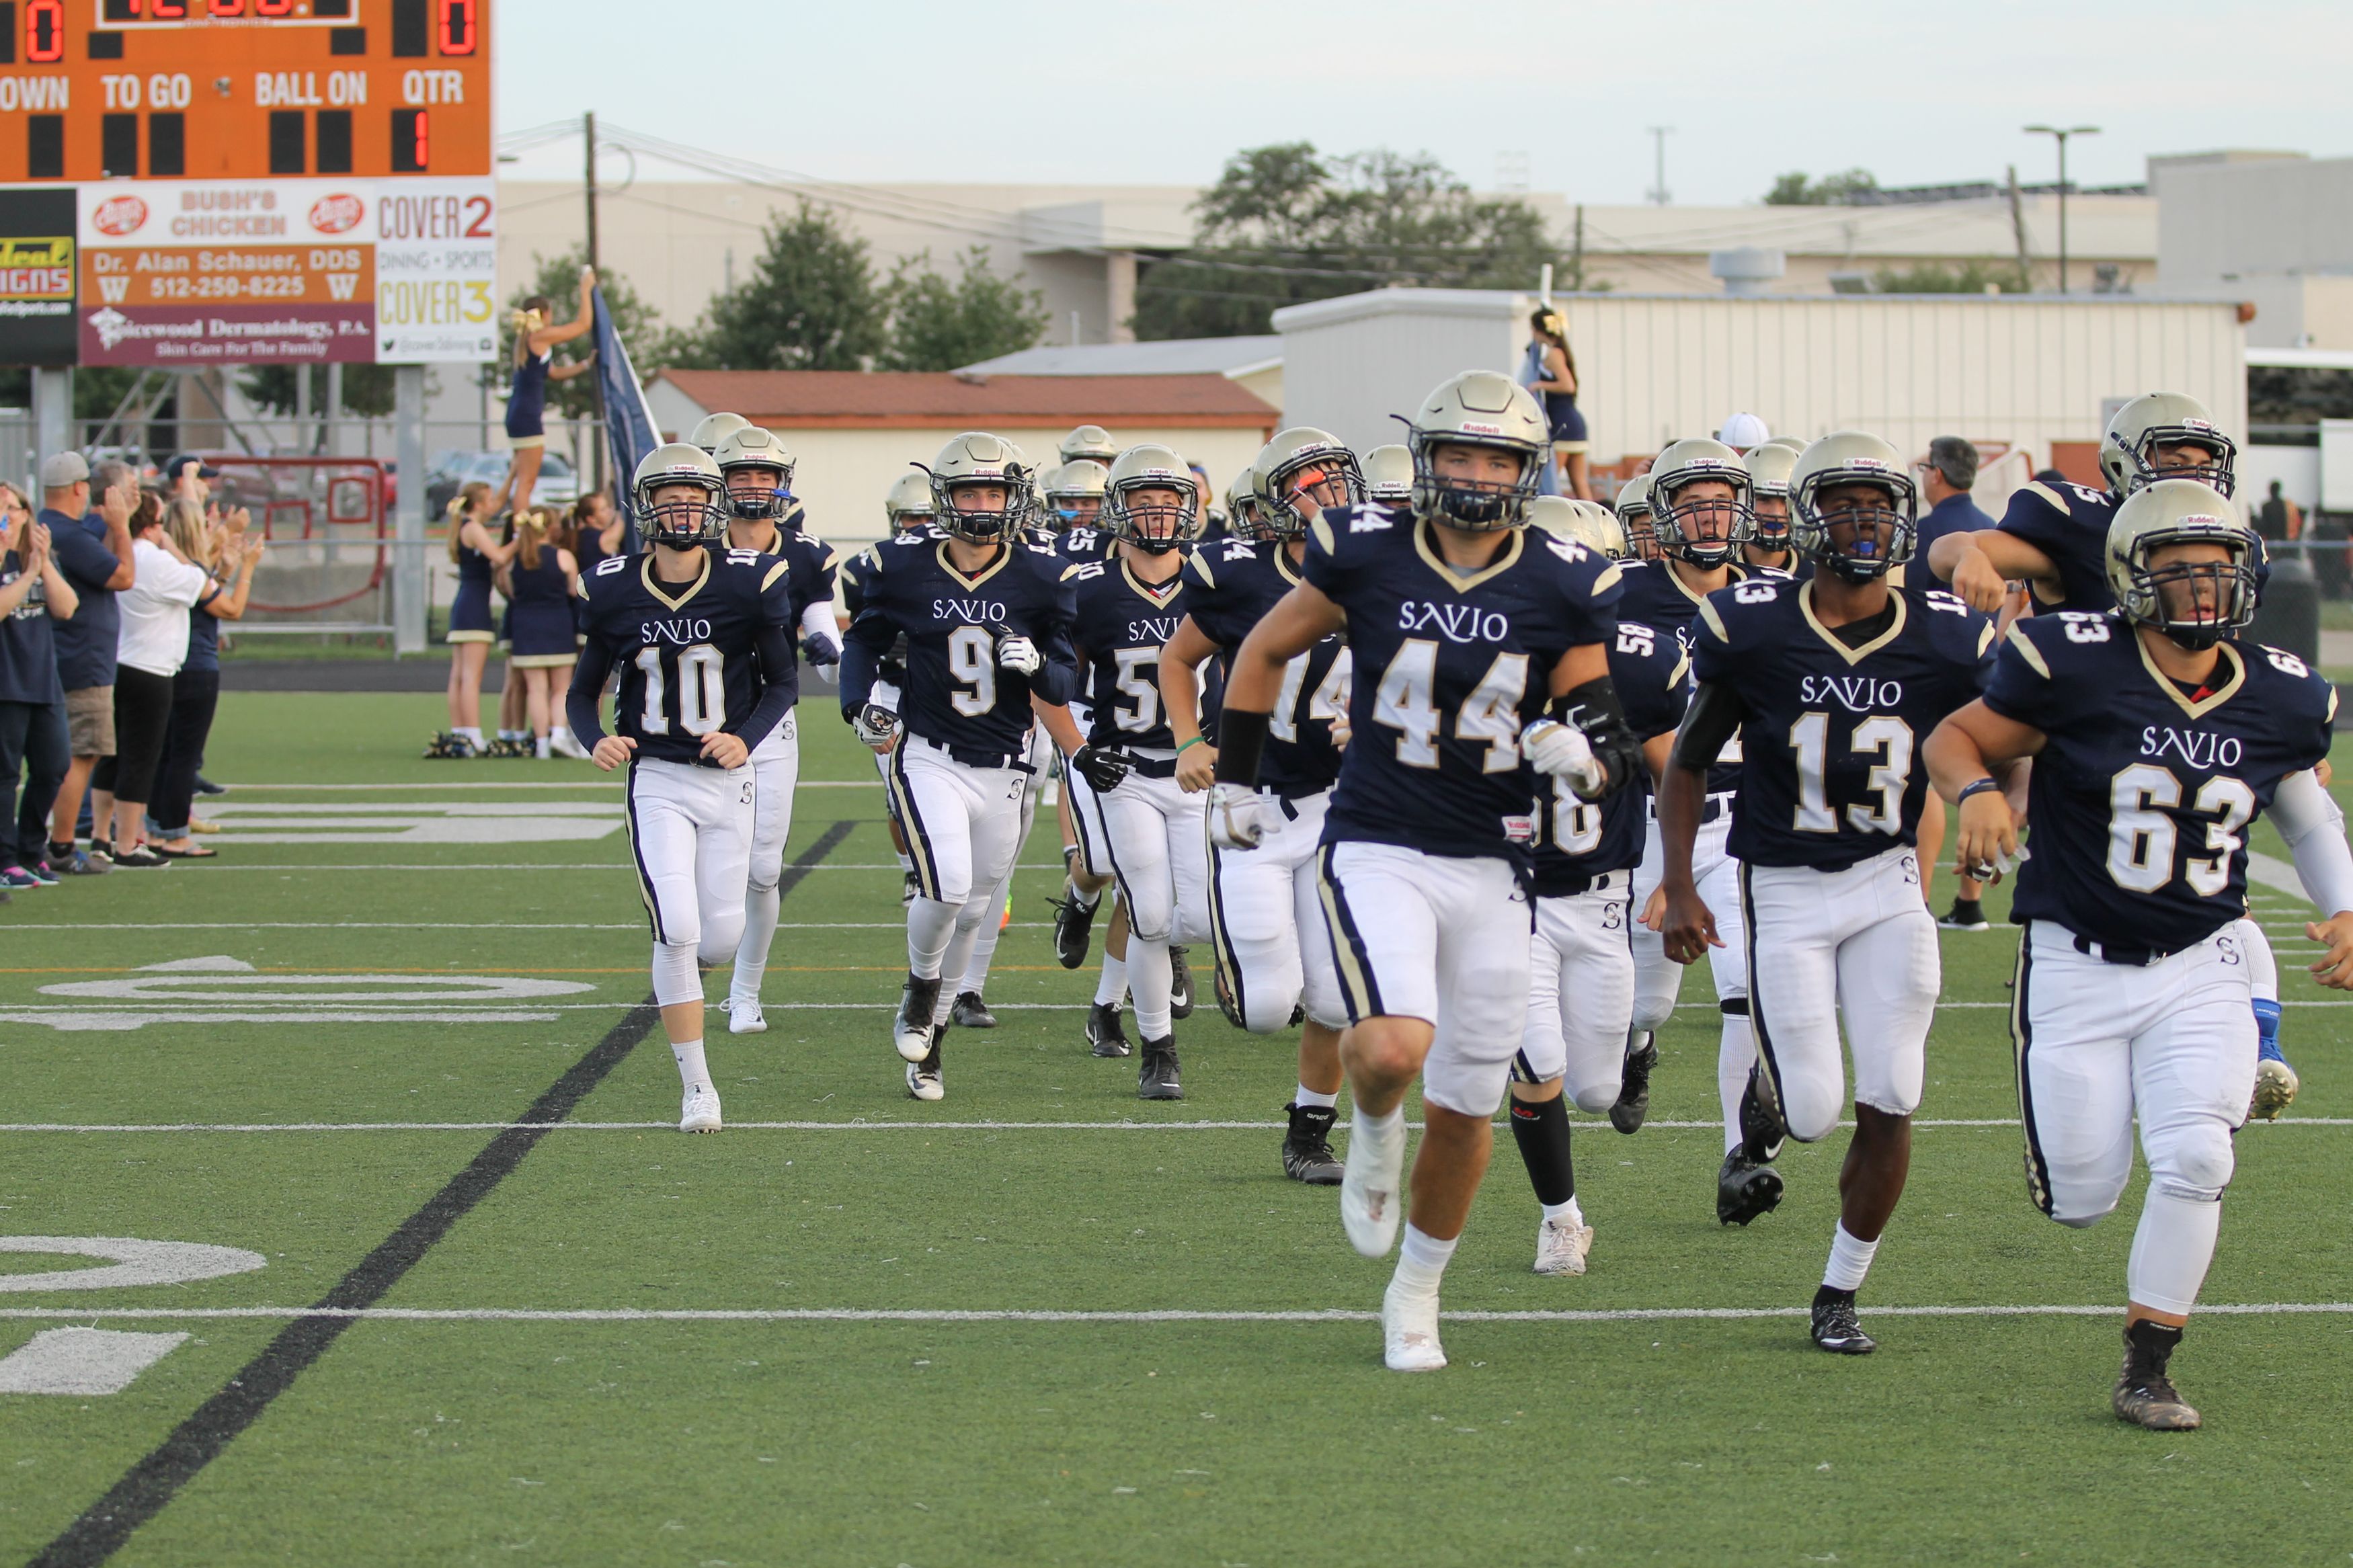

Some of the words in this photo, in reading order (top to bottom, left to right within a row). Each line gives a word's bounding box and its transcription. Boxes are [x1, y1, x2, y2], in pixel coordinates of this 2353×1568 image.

[100, 74, 141, 109] TO
[148, 73, 192, 108] GO
[255, 72, 323, 106] BALL
[328, 71, 367, 105] ON
[403, 69, 464, 104] QTR
[416, 112, 427, 166] 1
[172, 216, 286, 236] CHICKEN
[93, 252, 128, 273] Dr.
[135, 251, 190, 273] Alan
[198, 250, 302, 273] Schauer,
[309, 249, 361, 270] DDS
[380, 251, 430, 270] DINING
[445, 250, 493, 269] SPORTS
[151, 275, 305, 298] 512-250-8225
[1464, 423, 1500, 434] Riddell
[1853, 458, 1881, 466] Riddell
[1067, 527, 1099, 552] 25
[726, 548, 760, 567] 10
[1734, 579, 1778, 604] 13
[933, 598, 1006, 624] SAVIO
[1398, 601, 1508, 643] SAVIO
[2058, 611, 2110, 643] 63
[641, 618, 711, 645] SAVIO
[1128, 617, 1179, 643] SAVI
[1616, 622, 1655, 657] 58
[948, 626, 996, 717] 9
[635, 643, 727, 737] 10
[1372, 637, 1530, 775] 44
[1800, 675, 1903, 712] SAVIO
[2140, 726, 2242, 770] SAVIO
[1788, 710, 1914, 837] 13
[2106, 762, 2256, 897] 63
